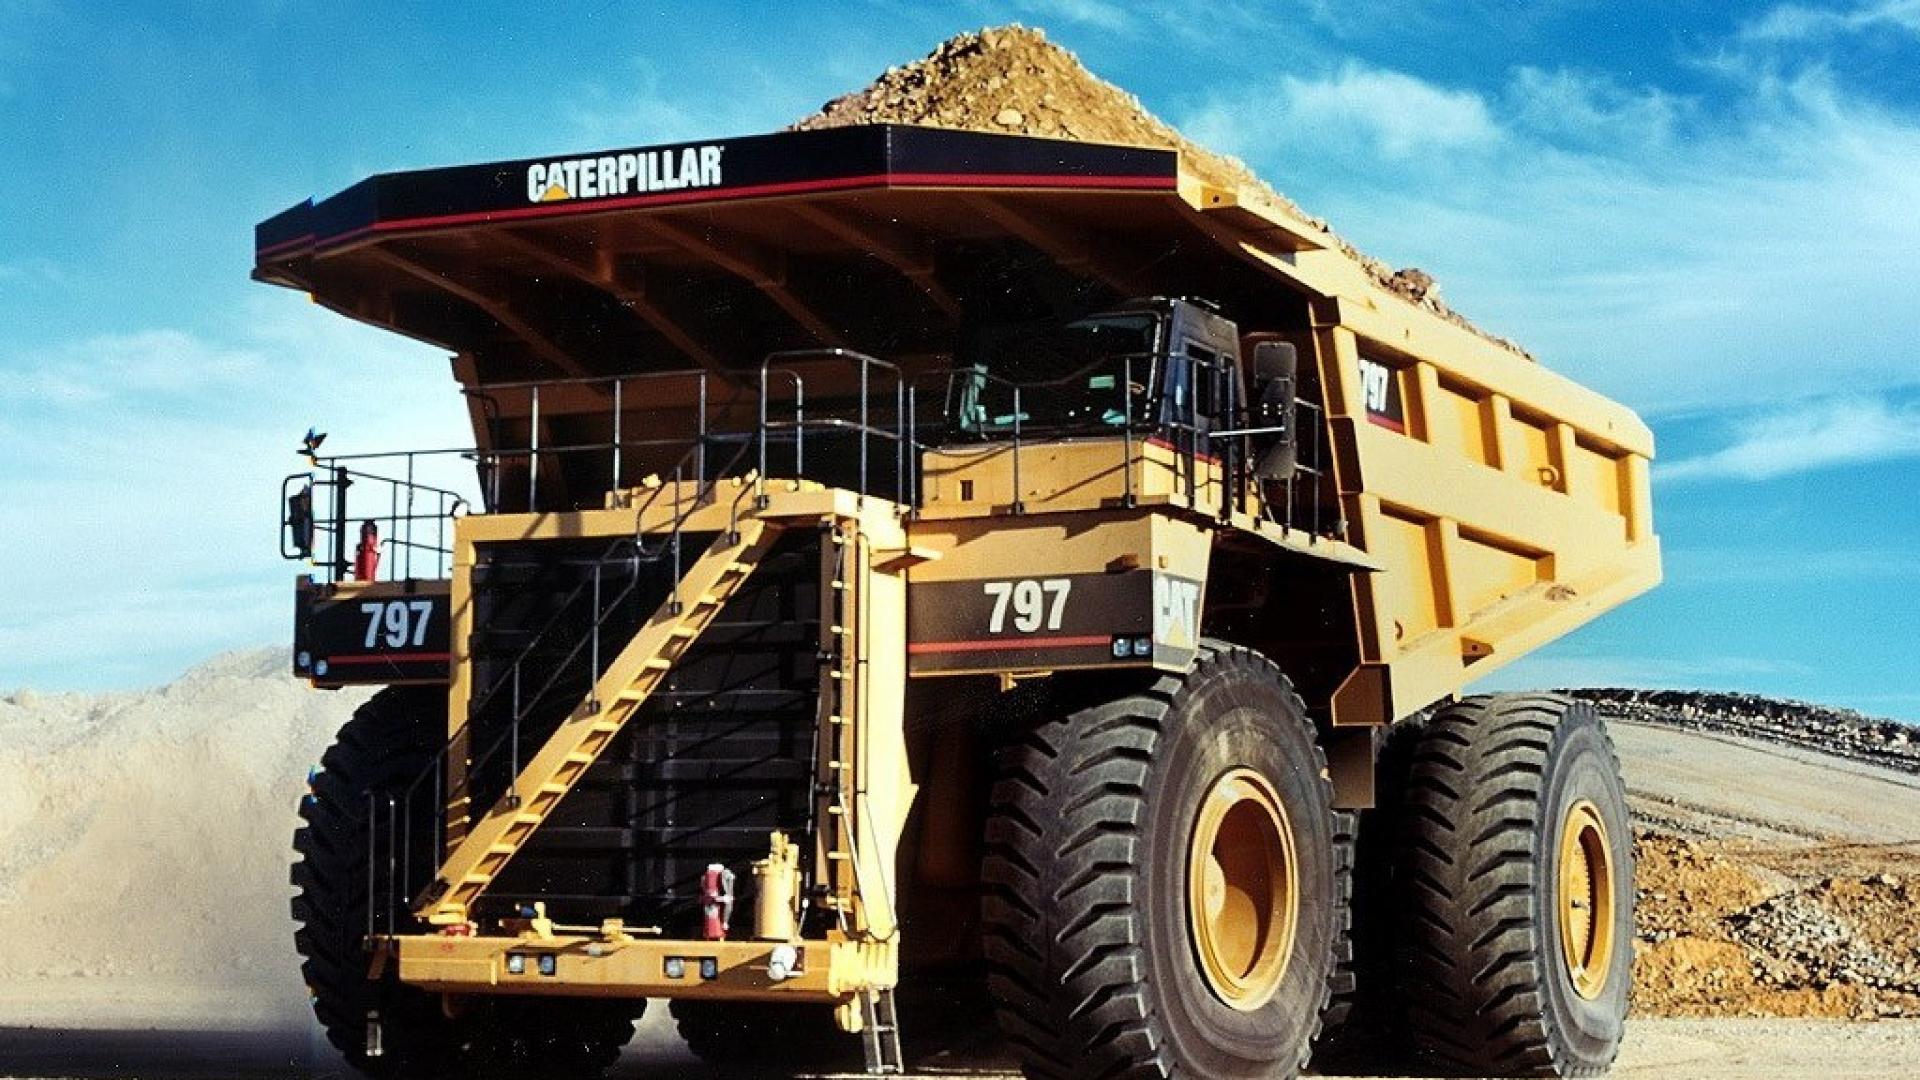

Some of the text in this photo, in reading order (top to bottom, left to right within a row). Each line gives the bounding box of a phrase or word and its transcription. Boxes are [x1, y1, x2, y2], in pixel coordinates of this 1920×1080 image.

[527, 145, 722, 203] CATERPILLAR
[361, 601, 433, 648] 797
[984, 579, 1071, 633] 797
[1153, 574, 1200, 649] CAT
